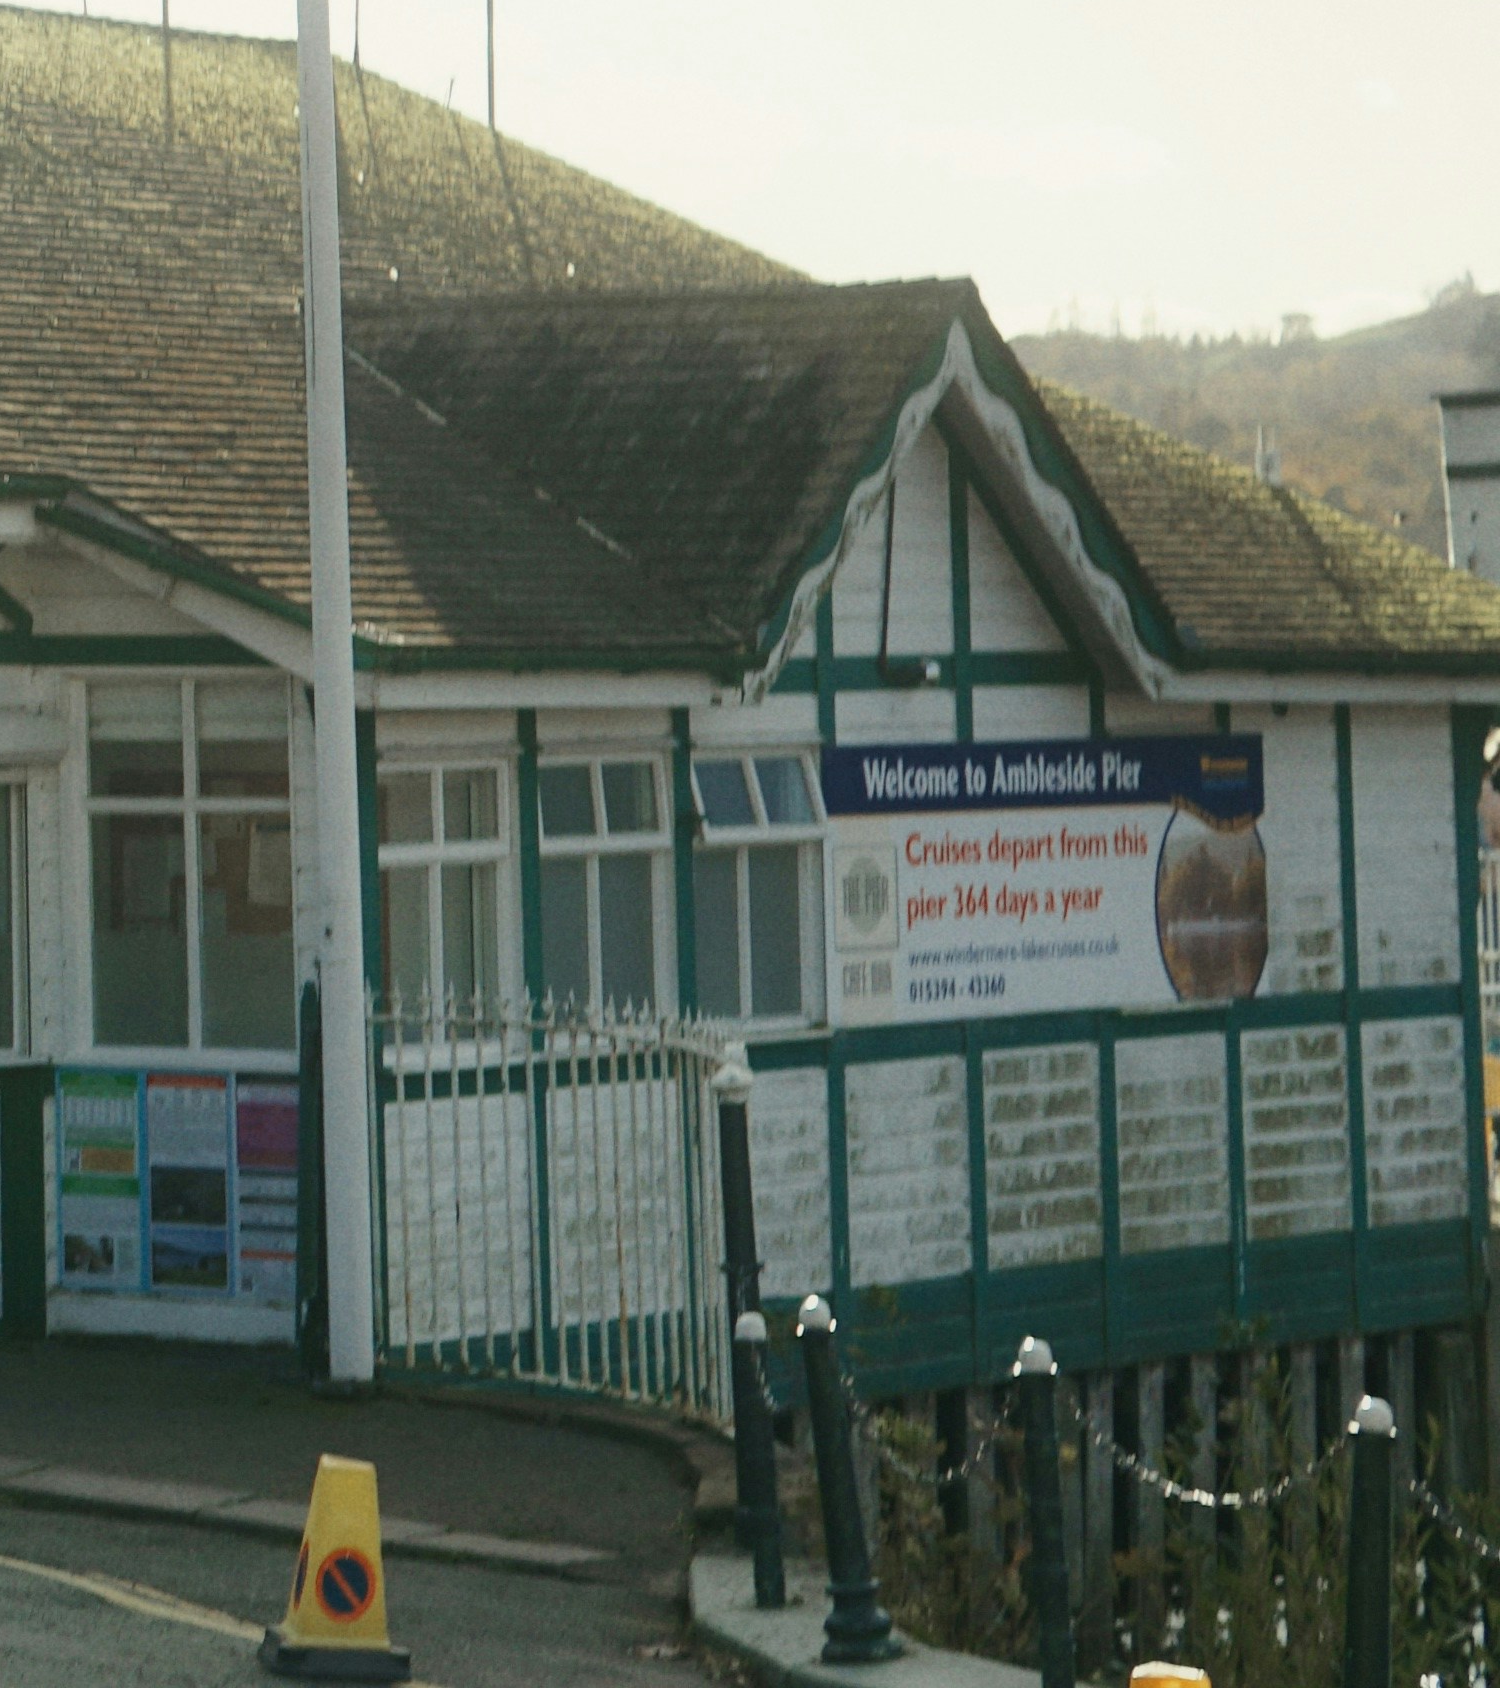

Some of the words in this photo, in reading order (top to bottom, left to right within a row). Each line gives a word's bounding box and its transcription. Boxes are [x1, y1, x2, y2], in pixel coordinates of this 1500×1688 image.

[863, 757, 959, 800] Welcome
[964, 758, 987, 797] to
[992, 752, 1096, 795] Ambleside
[1102, 750, 1142, 792] Pier
[906, 830, 981, 868] Cruises
[987, 827, 1054, 872] depart
[1060, 823, 1107, 859] from
[1113, 823, 1149, 857] this
[907, 888, 947, 931] pier
[953, 883, 989, 920] 364
[995, 883, 1038, 924] days
[1045, 889, 1055, 912] a
[1062, 886, 1103, 923] year
[909, 978, 956, 1003] 015394
